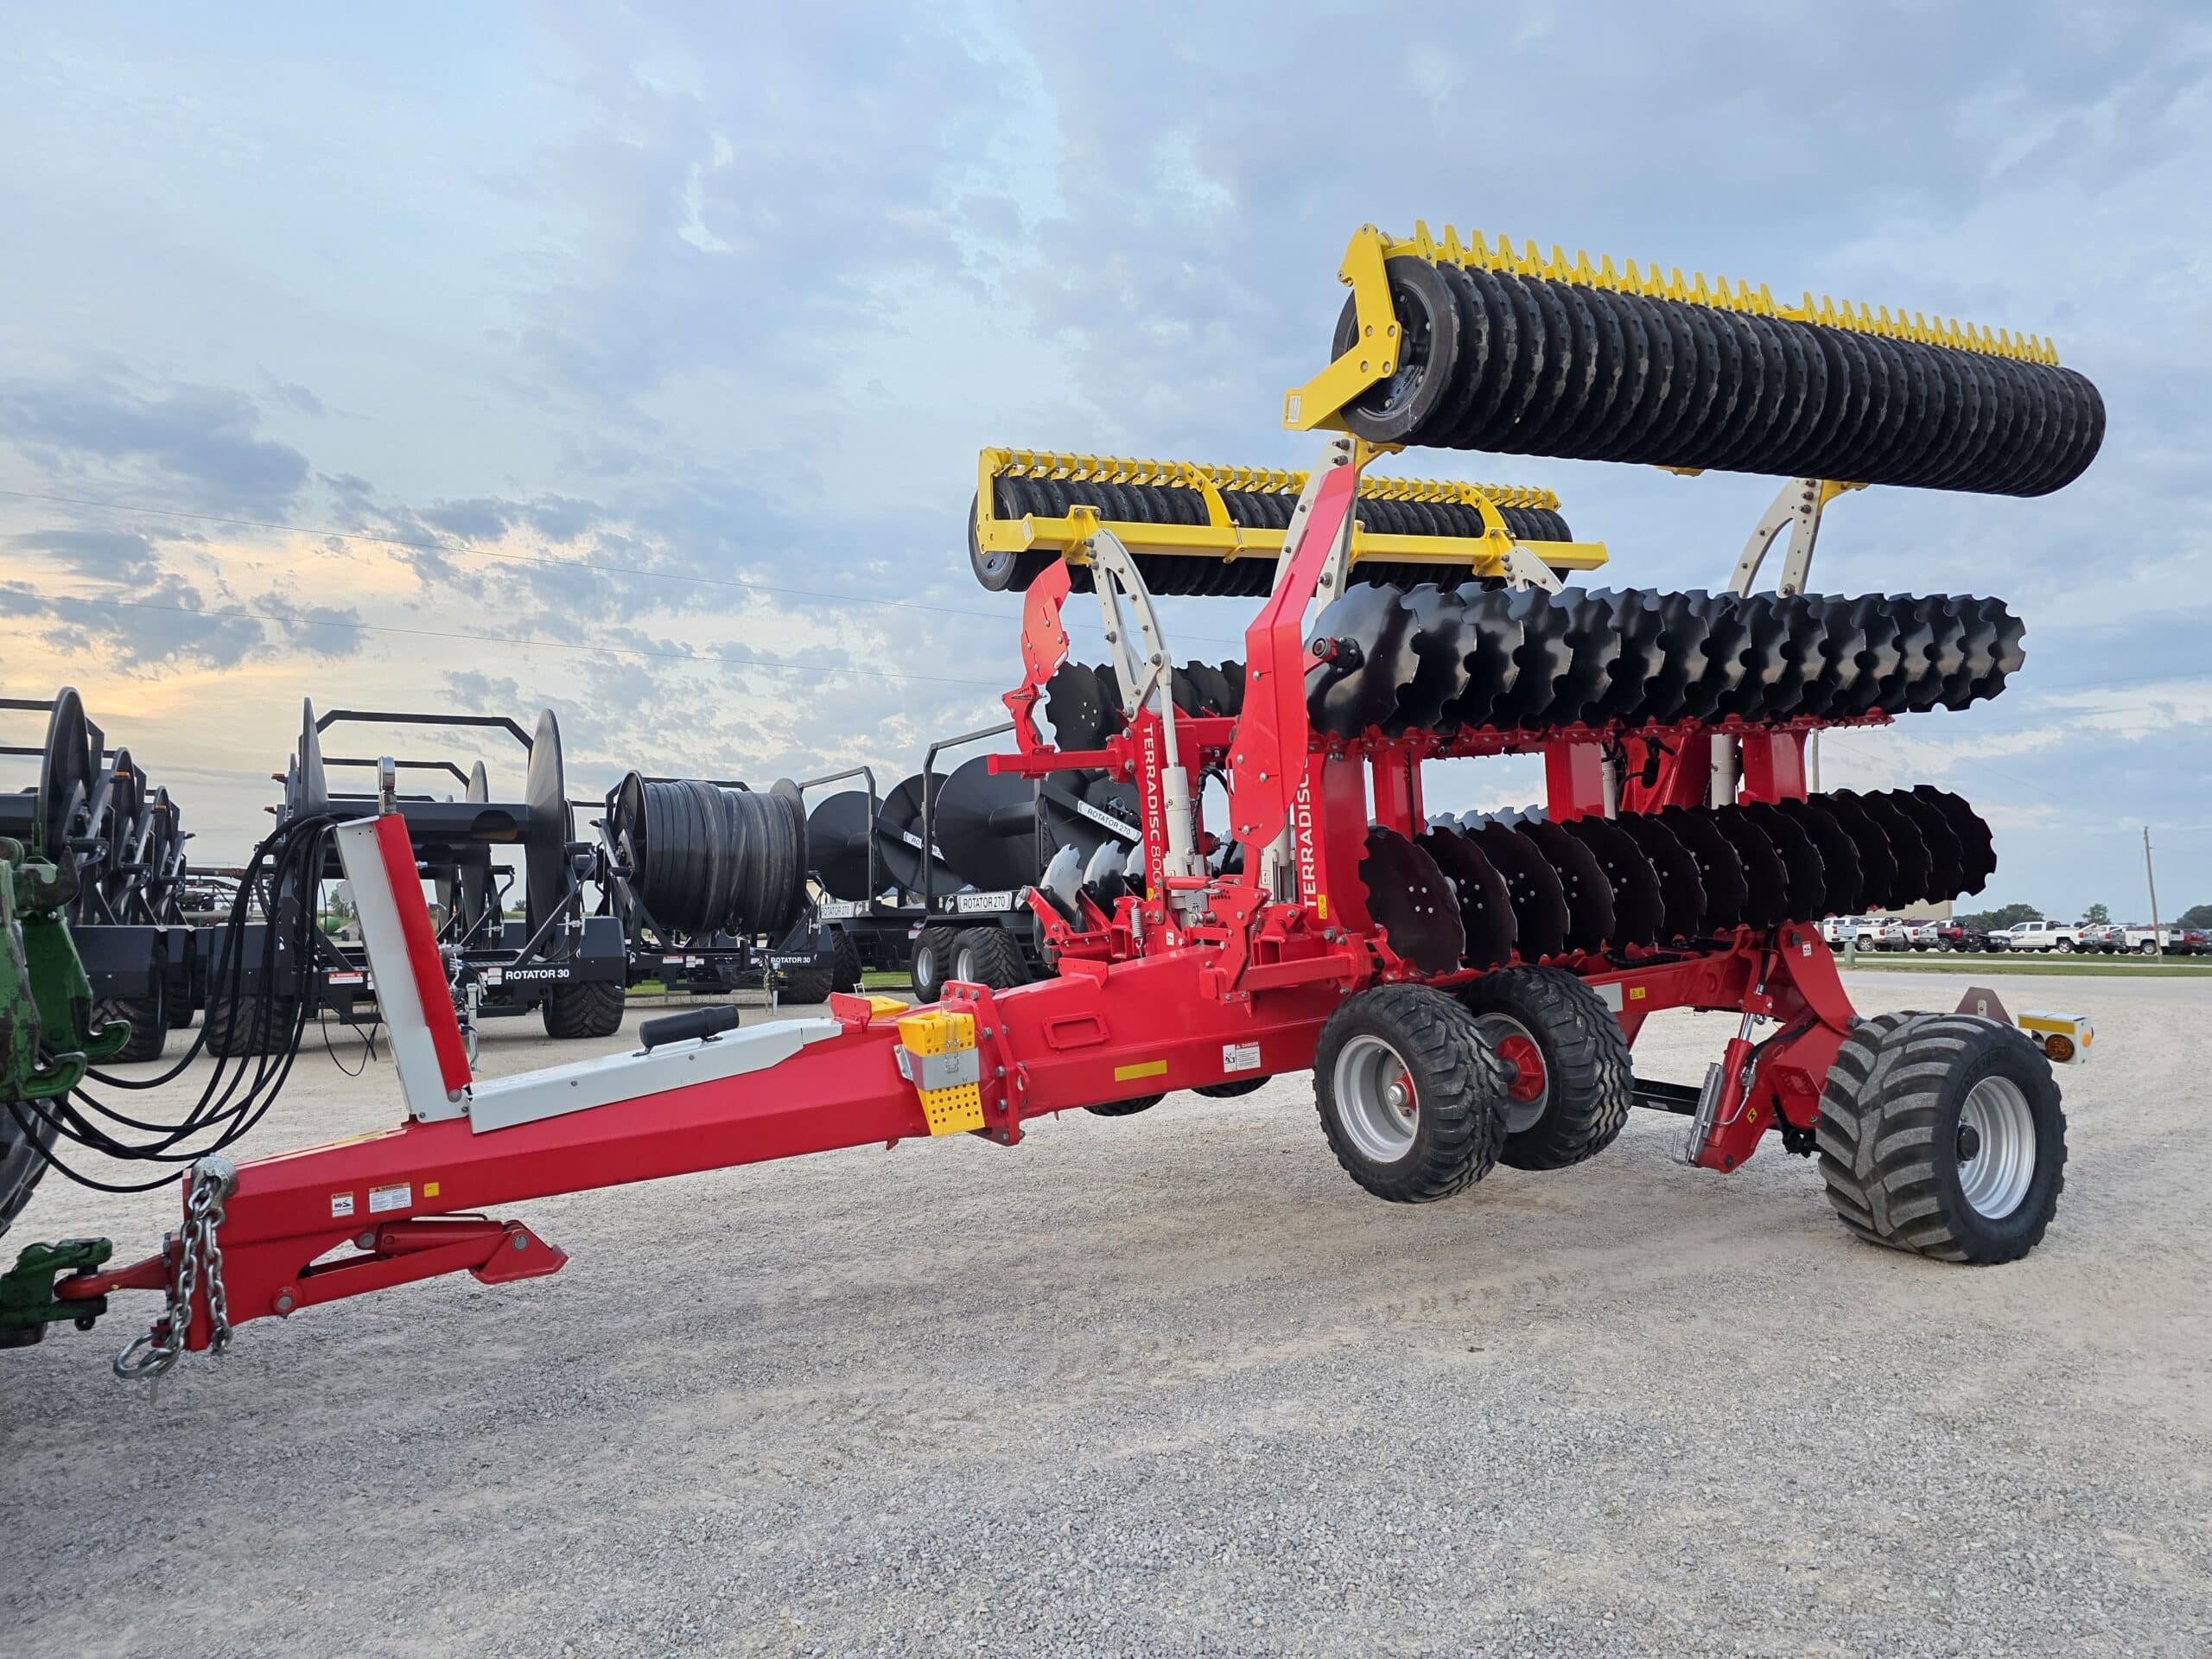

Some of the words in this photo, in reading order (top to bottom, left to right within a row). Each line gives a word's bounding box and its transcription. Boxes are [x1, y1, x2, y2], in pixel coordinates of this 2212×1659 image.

[1143, 722, 1160, 842] TERRADISC
[1087, 808, 1119, 830] ROTATOR
[1118, 824, 1131, 836] 270
[1151, 845, 1162, 888] 800
[963, 896, 993, 909] ROTATOR
[994, 895, 1006, 907] 270
[505, 969, 556, 980] ROTATOR
[557, 969, 570, 978] 30
